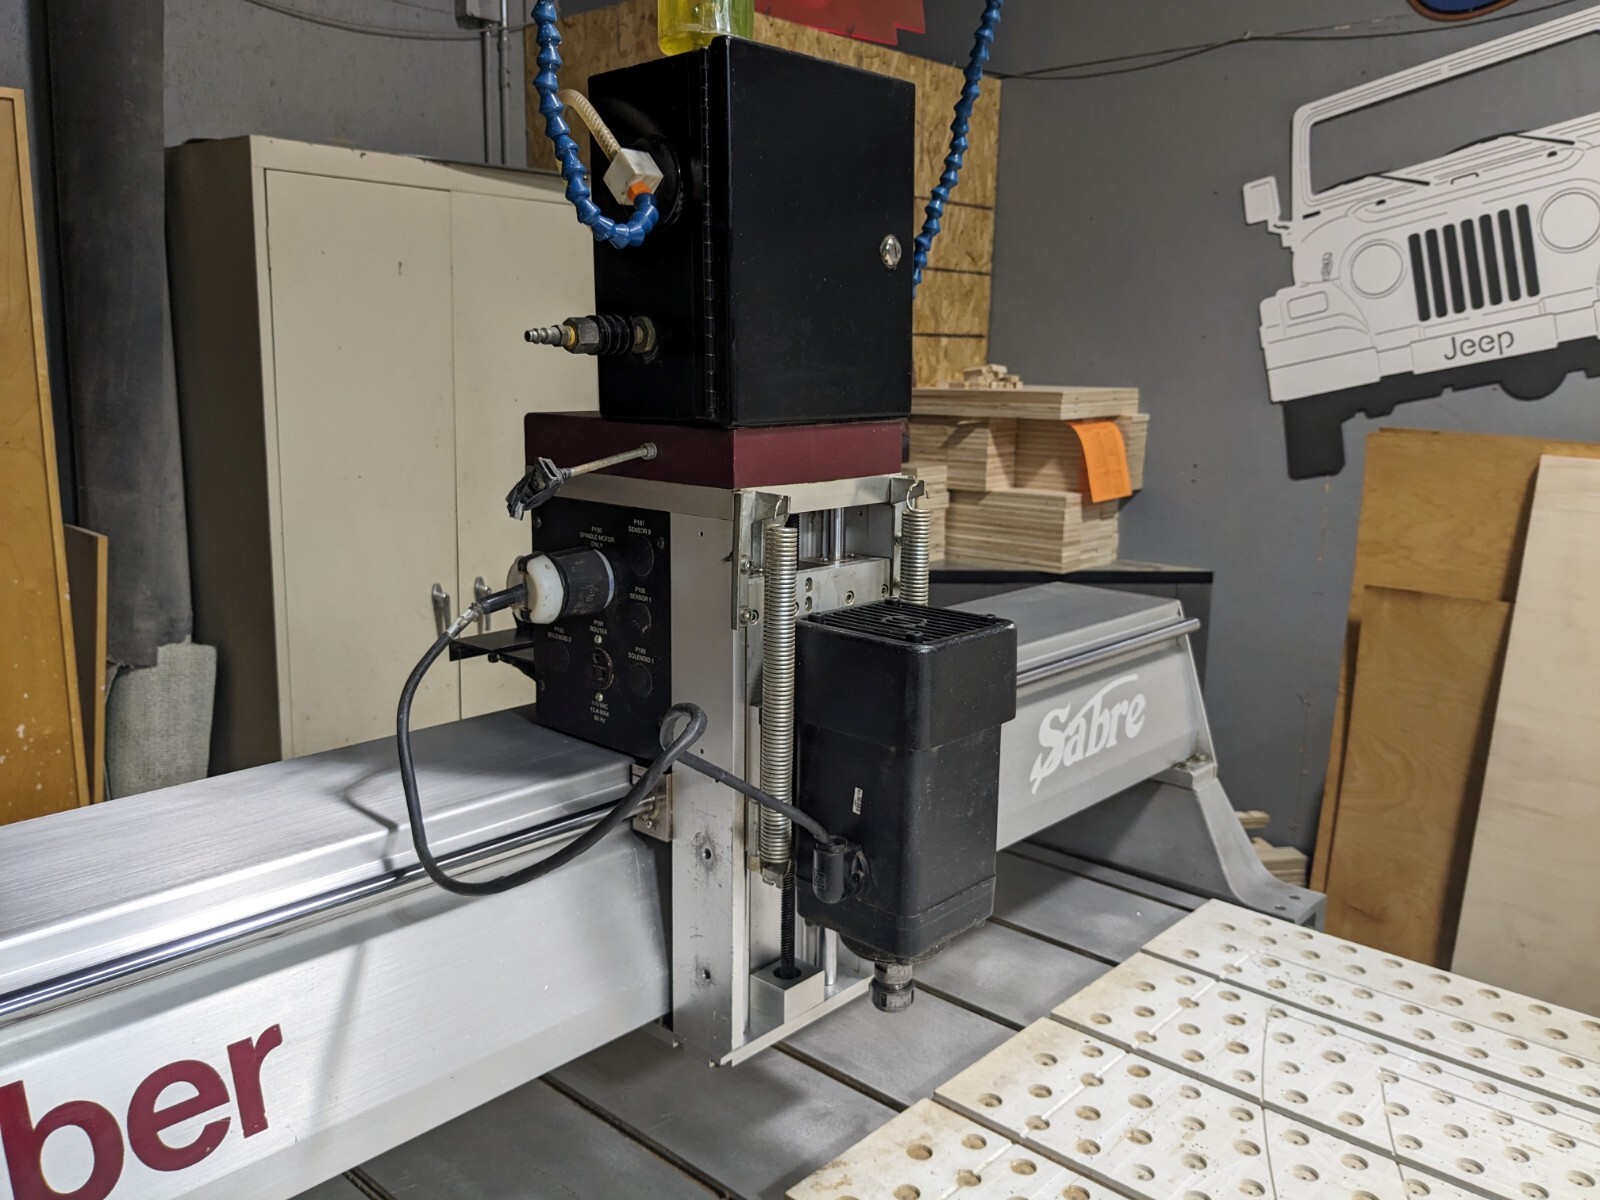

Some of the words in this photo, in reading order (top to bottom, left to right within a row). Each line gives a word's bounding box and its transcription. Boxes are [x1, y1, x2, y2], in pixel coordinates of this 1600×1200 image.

[1444, 331, 1514, 360] Jeep
[627, 525, 647, 535] SENSOR
[579, 531, 598, 540] SPINDLE
[597, 534, 615, 543] MOTOR
[590, 541, 603, 549] ONLY
[629, 592, 648, 602] SENSOR
[589, 626, 608, 635] ROUTER
[547, 632, 568, 642] SOLENOID
[628, 652, 651, 663] SOLENOID
[1029, 673, 1146, 795] Sabre
